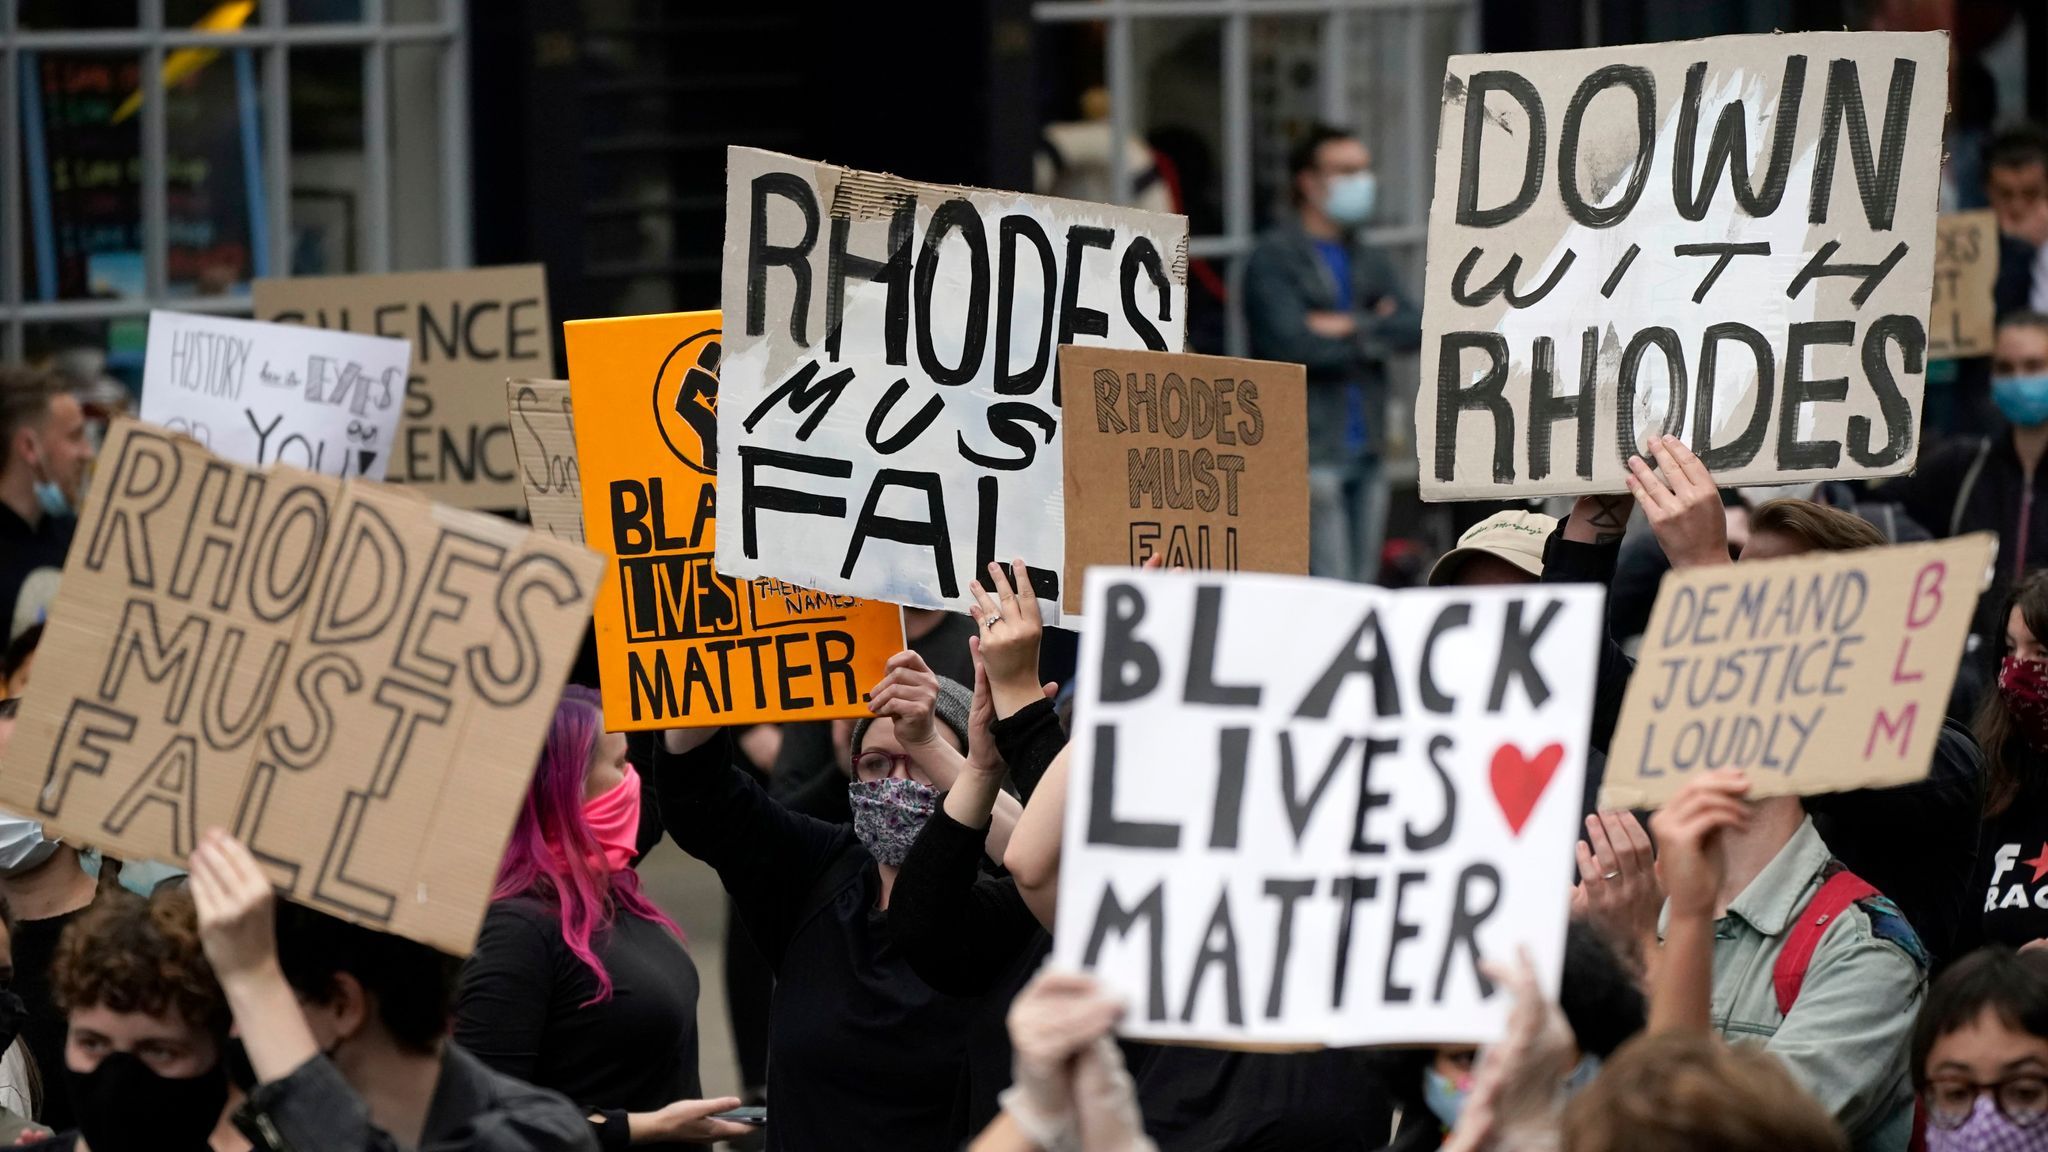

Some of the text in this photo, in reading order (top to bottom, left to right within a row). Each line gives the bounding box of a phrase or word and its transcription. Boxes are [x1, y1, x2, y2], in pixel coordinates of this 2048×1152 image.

[1456, 54, 1917, 230] DOWN
[1451, 241, 1909, 310] WITH
[170, 331, 252, 401] HISTORY
[304, 354, 401, 418] EYES
[1093, 368, 1265, 446] RHODES
[1434, 314, 1927, 485] RHODES
[741, 359, 1057, 470] MUS
[1128, 447, 1245, 517] MUST
[85, 429, 583, 707] RHODES
[623, 557, 739, 639] LIVES
[1661, 568, 1870, 649] DEMAND
[1099, 582, 1567, 719] BLACK
[1651, 634, 1865, 712] JUSTICE
[100, 598, 454, 800] MUST
[1637, 706, 1825, 778] LOUDLY
[38, 698, 397, 923] FALL
[1086, 721, 1458, 854] LIVES
[1082, 861, 1503, 1027] MATTER
